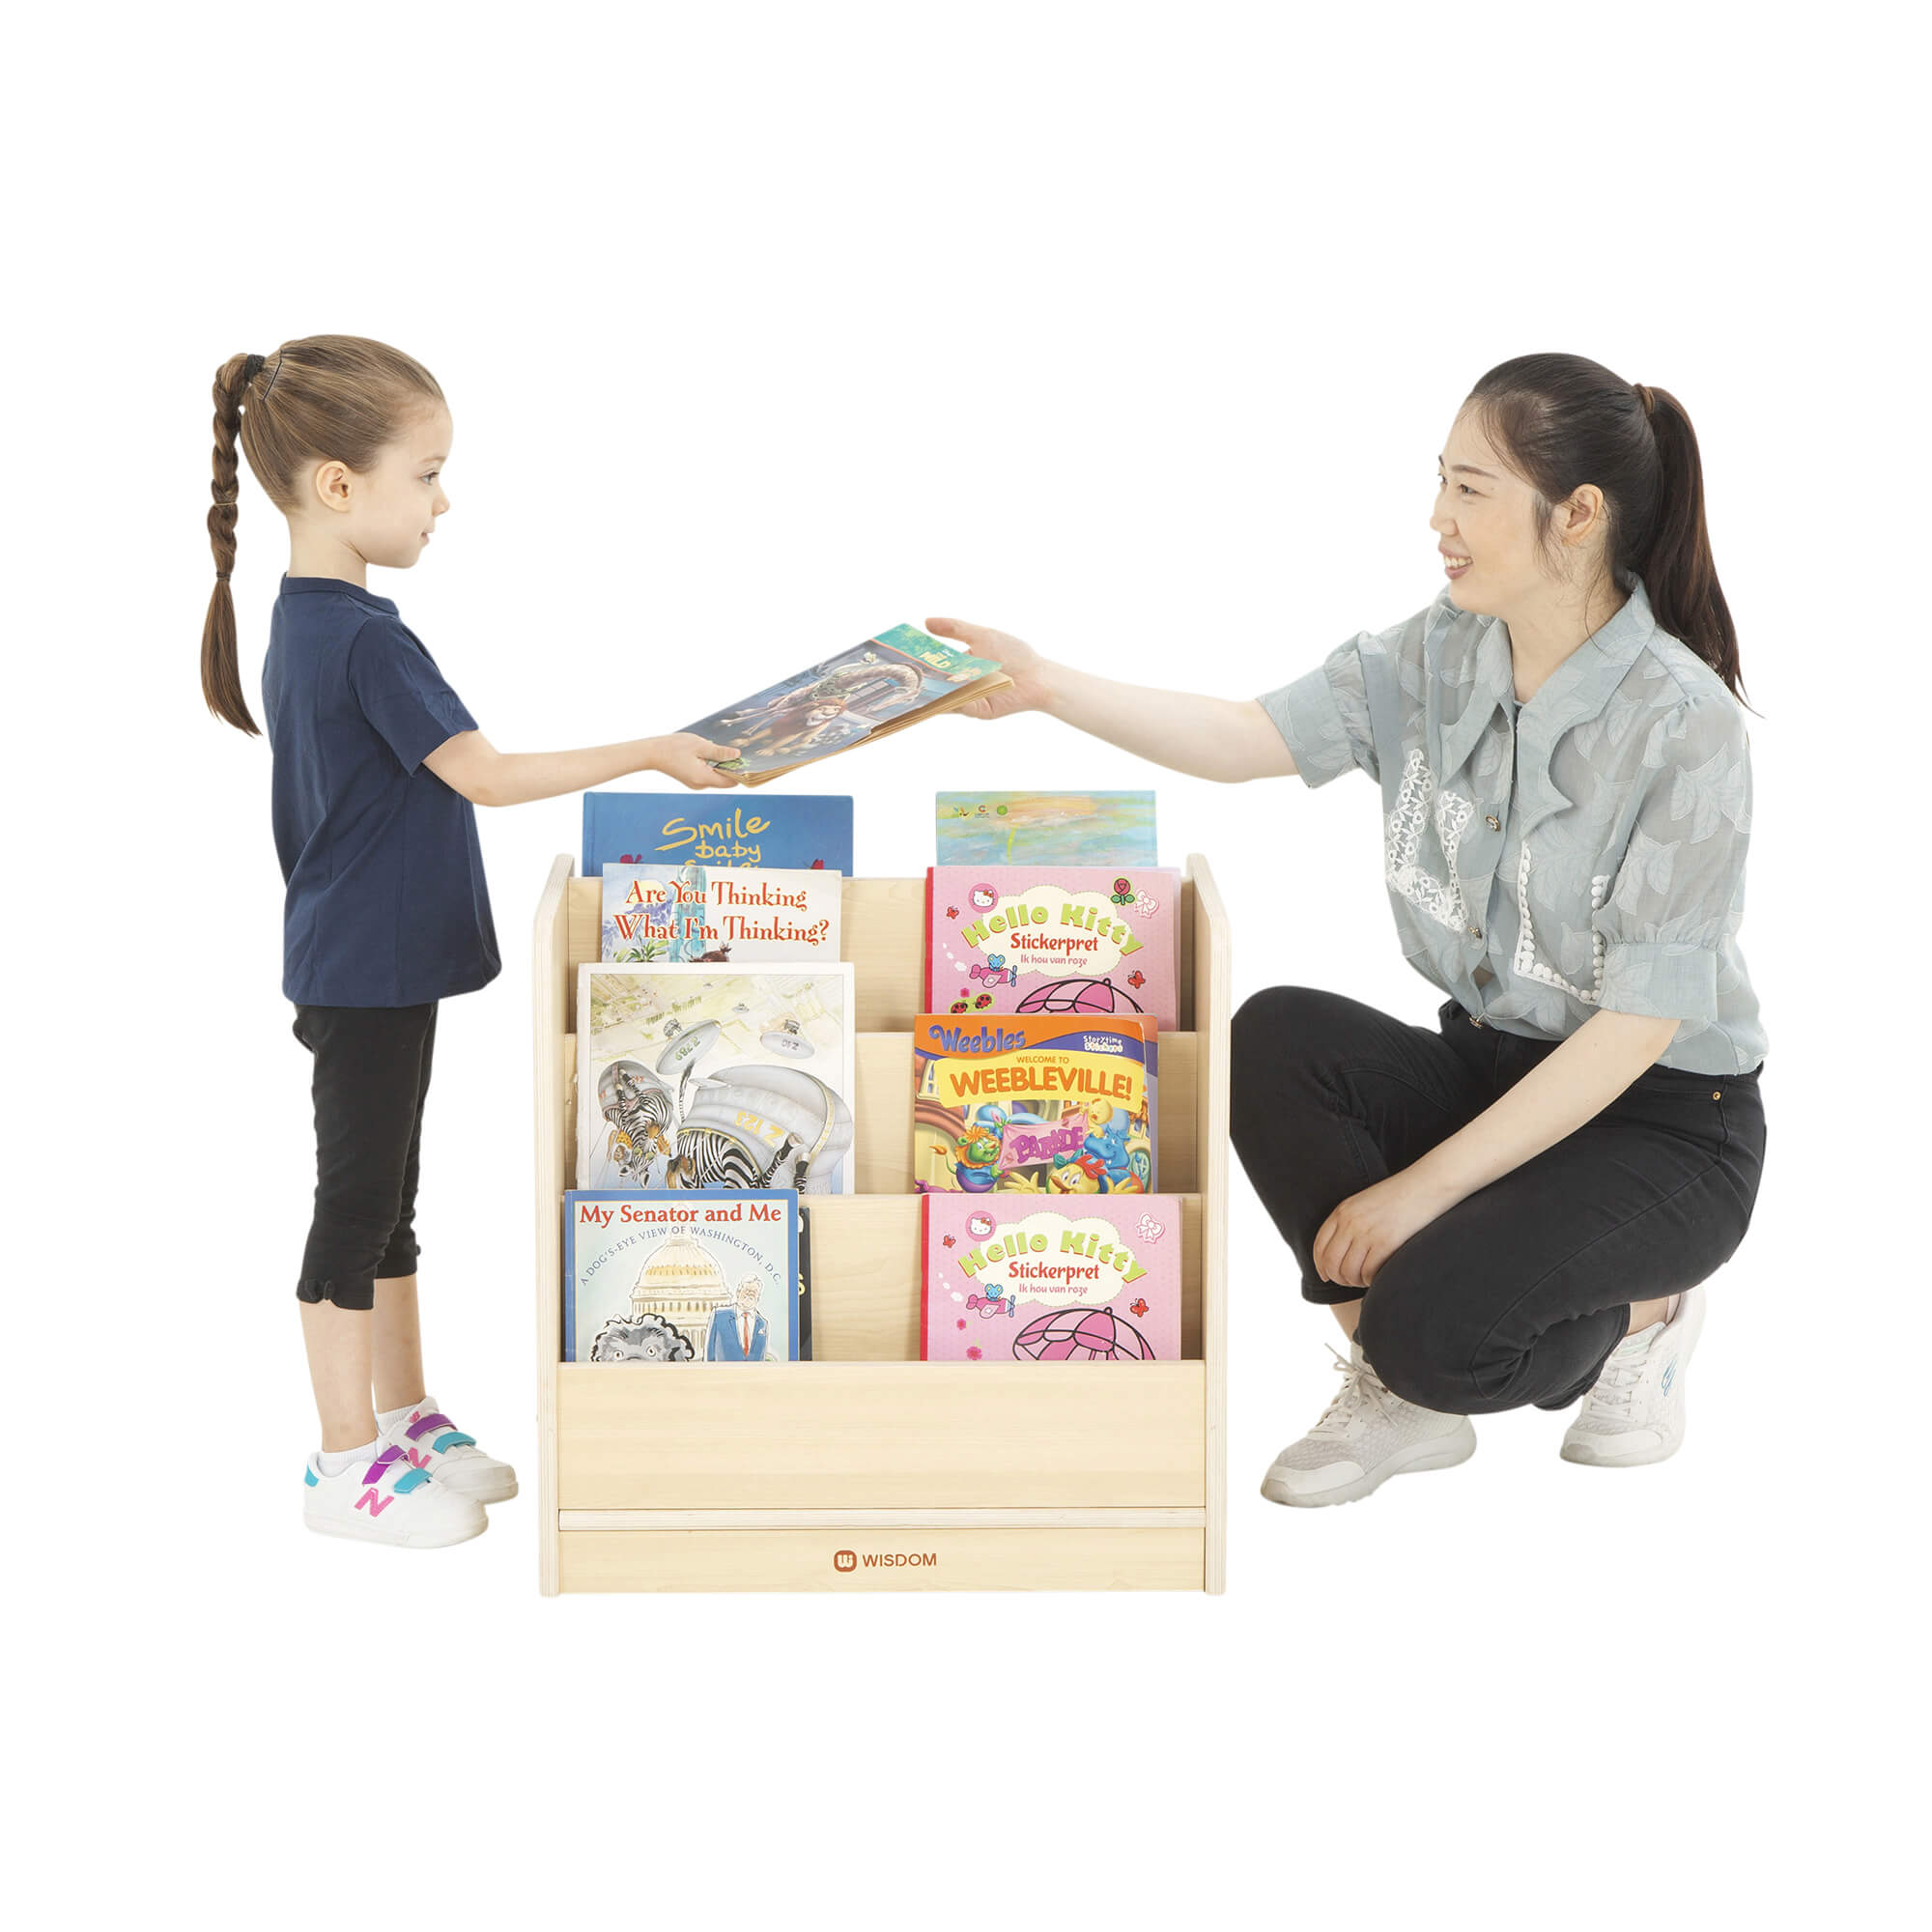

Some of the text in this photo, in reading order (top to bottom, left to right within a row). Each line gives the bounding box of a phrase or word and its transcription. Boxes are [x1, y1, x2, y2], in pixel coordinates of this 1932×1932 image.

[654, 808, 771, 850] Smile
[695, 839, 761, 863] baby
[626, 880, 808, 911] Are You Thinking
[613, 914, 830, 947] What I'm Thinking?
[961, 902, 1145, 956] Hello Kitty
[1010, 932, 1098, 956] Stickerpret
[1020, 953, 1088, 968] Ik hou van roze
[928, 1024, 1026, 1053] Weebles
[1016, 1055, 1069, 1065] WELCOME TO
[950, 1065, 1132, 1101] WEEBLEVILLE!
[1009, 1126, 1083, 1164] PARADE
[580, 1204, 781, 1229] My Senator and Me
[580, 1277, 589, 1286] A
[585, 1236, 638, 1277] DOG'S-EYE
[639, 1227, 668, 1241] VIEW
[670, 1226, 687, 1236] OF
[690, 1226, 763, 1265] WASHINGTON,
[764, 1263, 781, 1286] D.C.
[957, 1230, 1148, 1284] Hello Kitty
[1009, 1261, 1100, 1285] Stickerpret
[1019, 1283, 1088, 1296] Ik hou van roze
[354, 1487, 395, 1518] N
[863, 1553, 937, 1567] WISDOM
